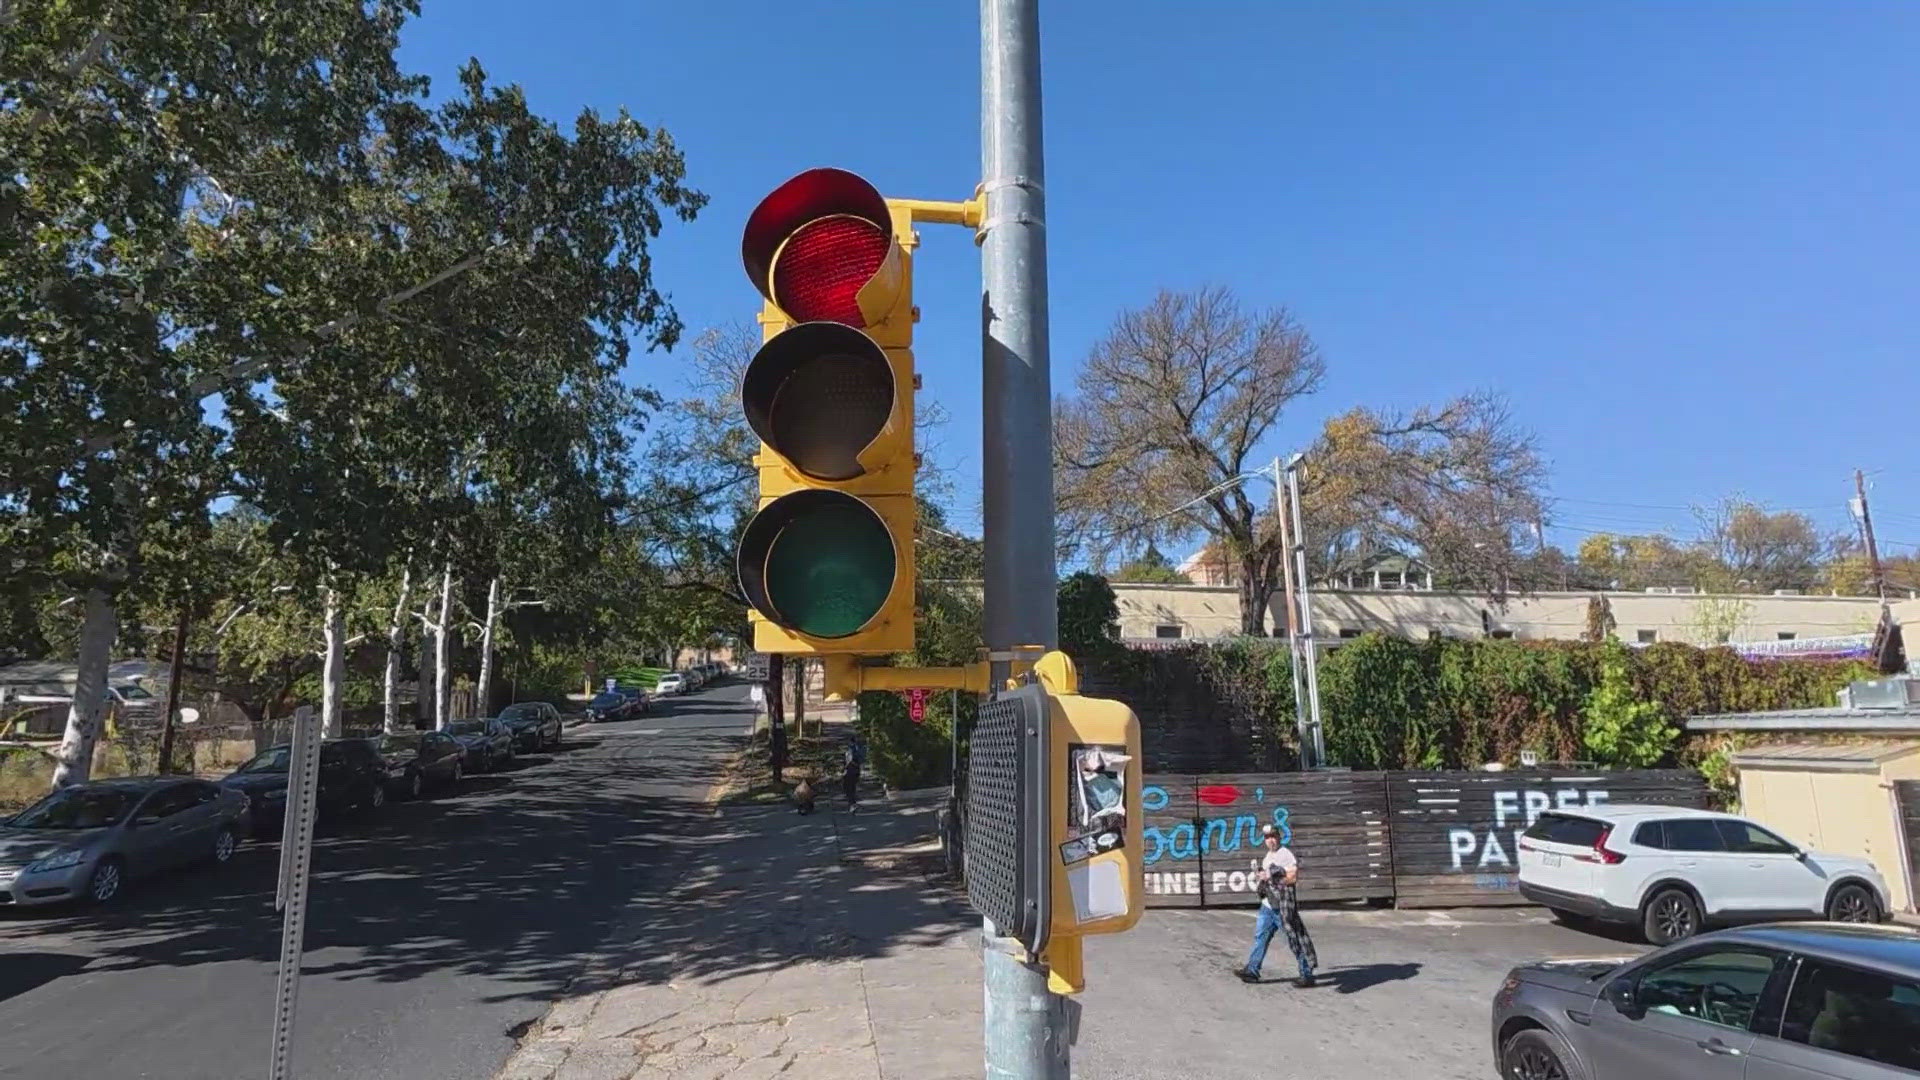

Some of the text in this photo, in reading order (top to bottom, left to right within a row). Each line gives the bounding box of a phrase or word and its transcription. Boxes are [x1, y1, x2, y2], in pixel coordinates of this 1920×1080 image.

[749, 667, 767, 678] 25
[1142, 784, 1292, 866] oann's
[1212, 871, 1262, 892] FOO
